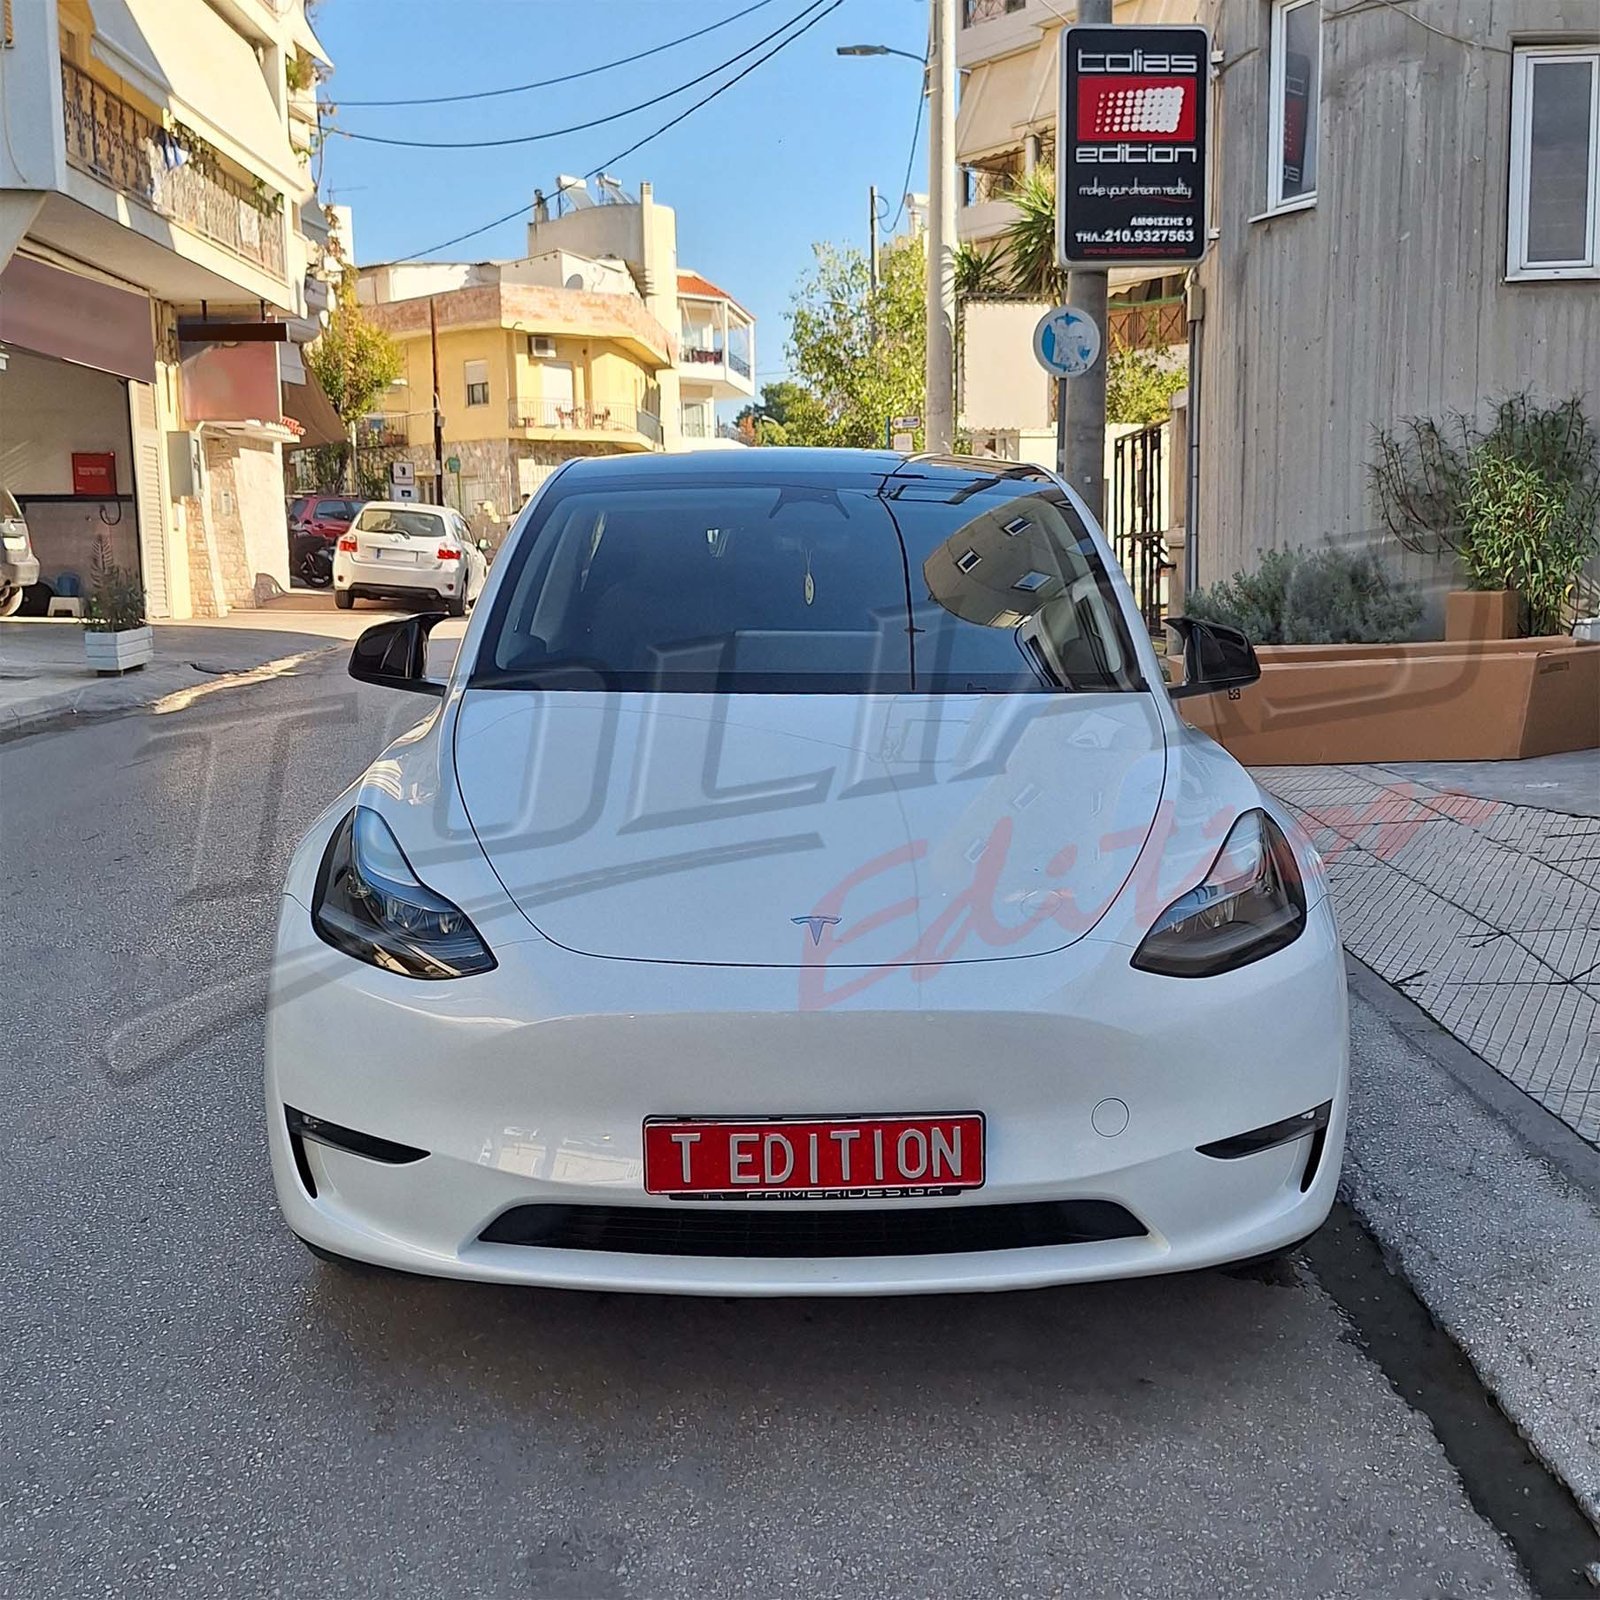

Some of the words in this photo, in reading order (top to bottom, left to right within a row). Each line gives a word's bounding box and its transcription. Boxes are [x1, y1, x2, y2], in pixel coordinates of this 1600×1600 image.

[1077, 48, 1198, 73] tolias
[1075, 143, 1197, 163] edition
[1078, 177, 1106, 197] make
[1107, 186, 1129, 199] your
[1129, 177, 1161, 195] dream
[1163, 177, 1192, 199] reality
[1129, 217, 1184, 227] ΑΜΦΙΣΣΗΣ
[1186, 217, 1193, 227] 9
[671, 1133, 701, 1184] T
[730, 1126, 962, 1184] EDITION
